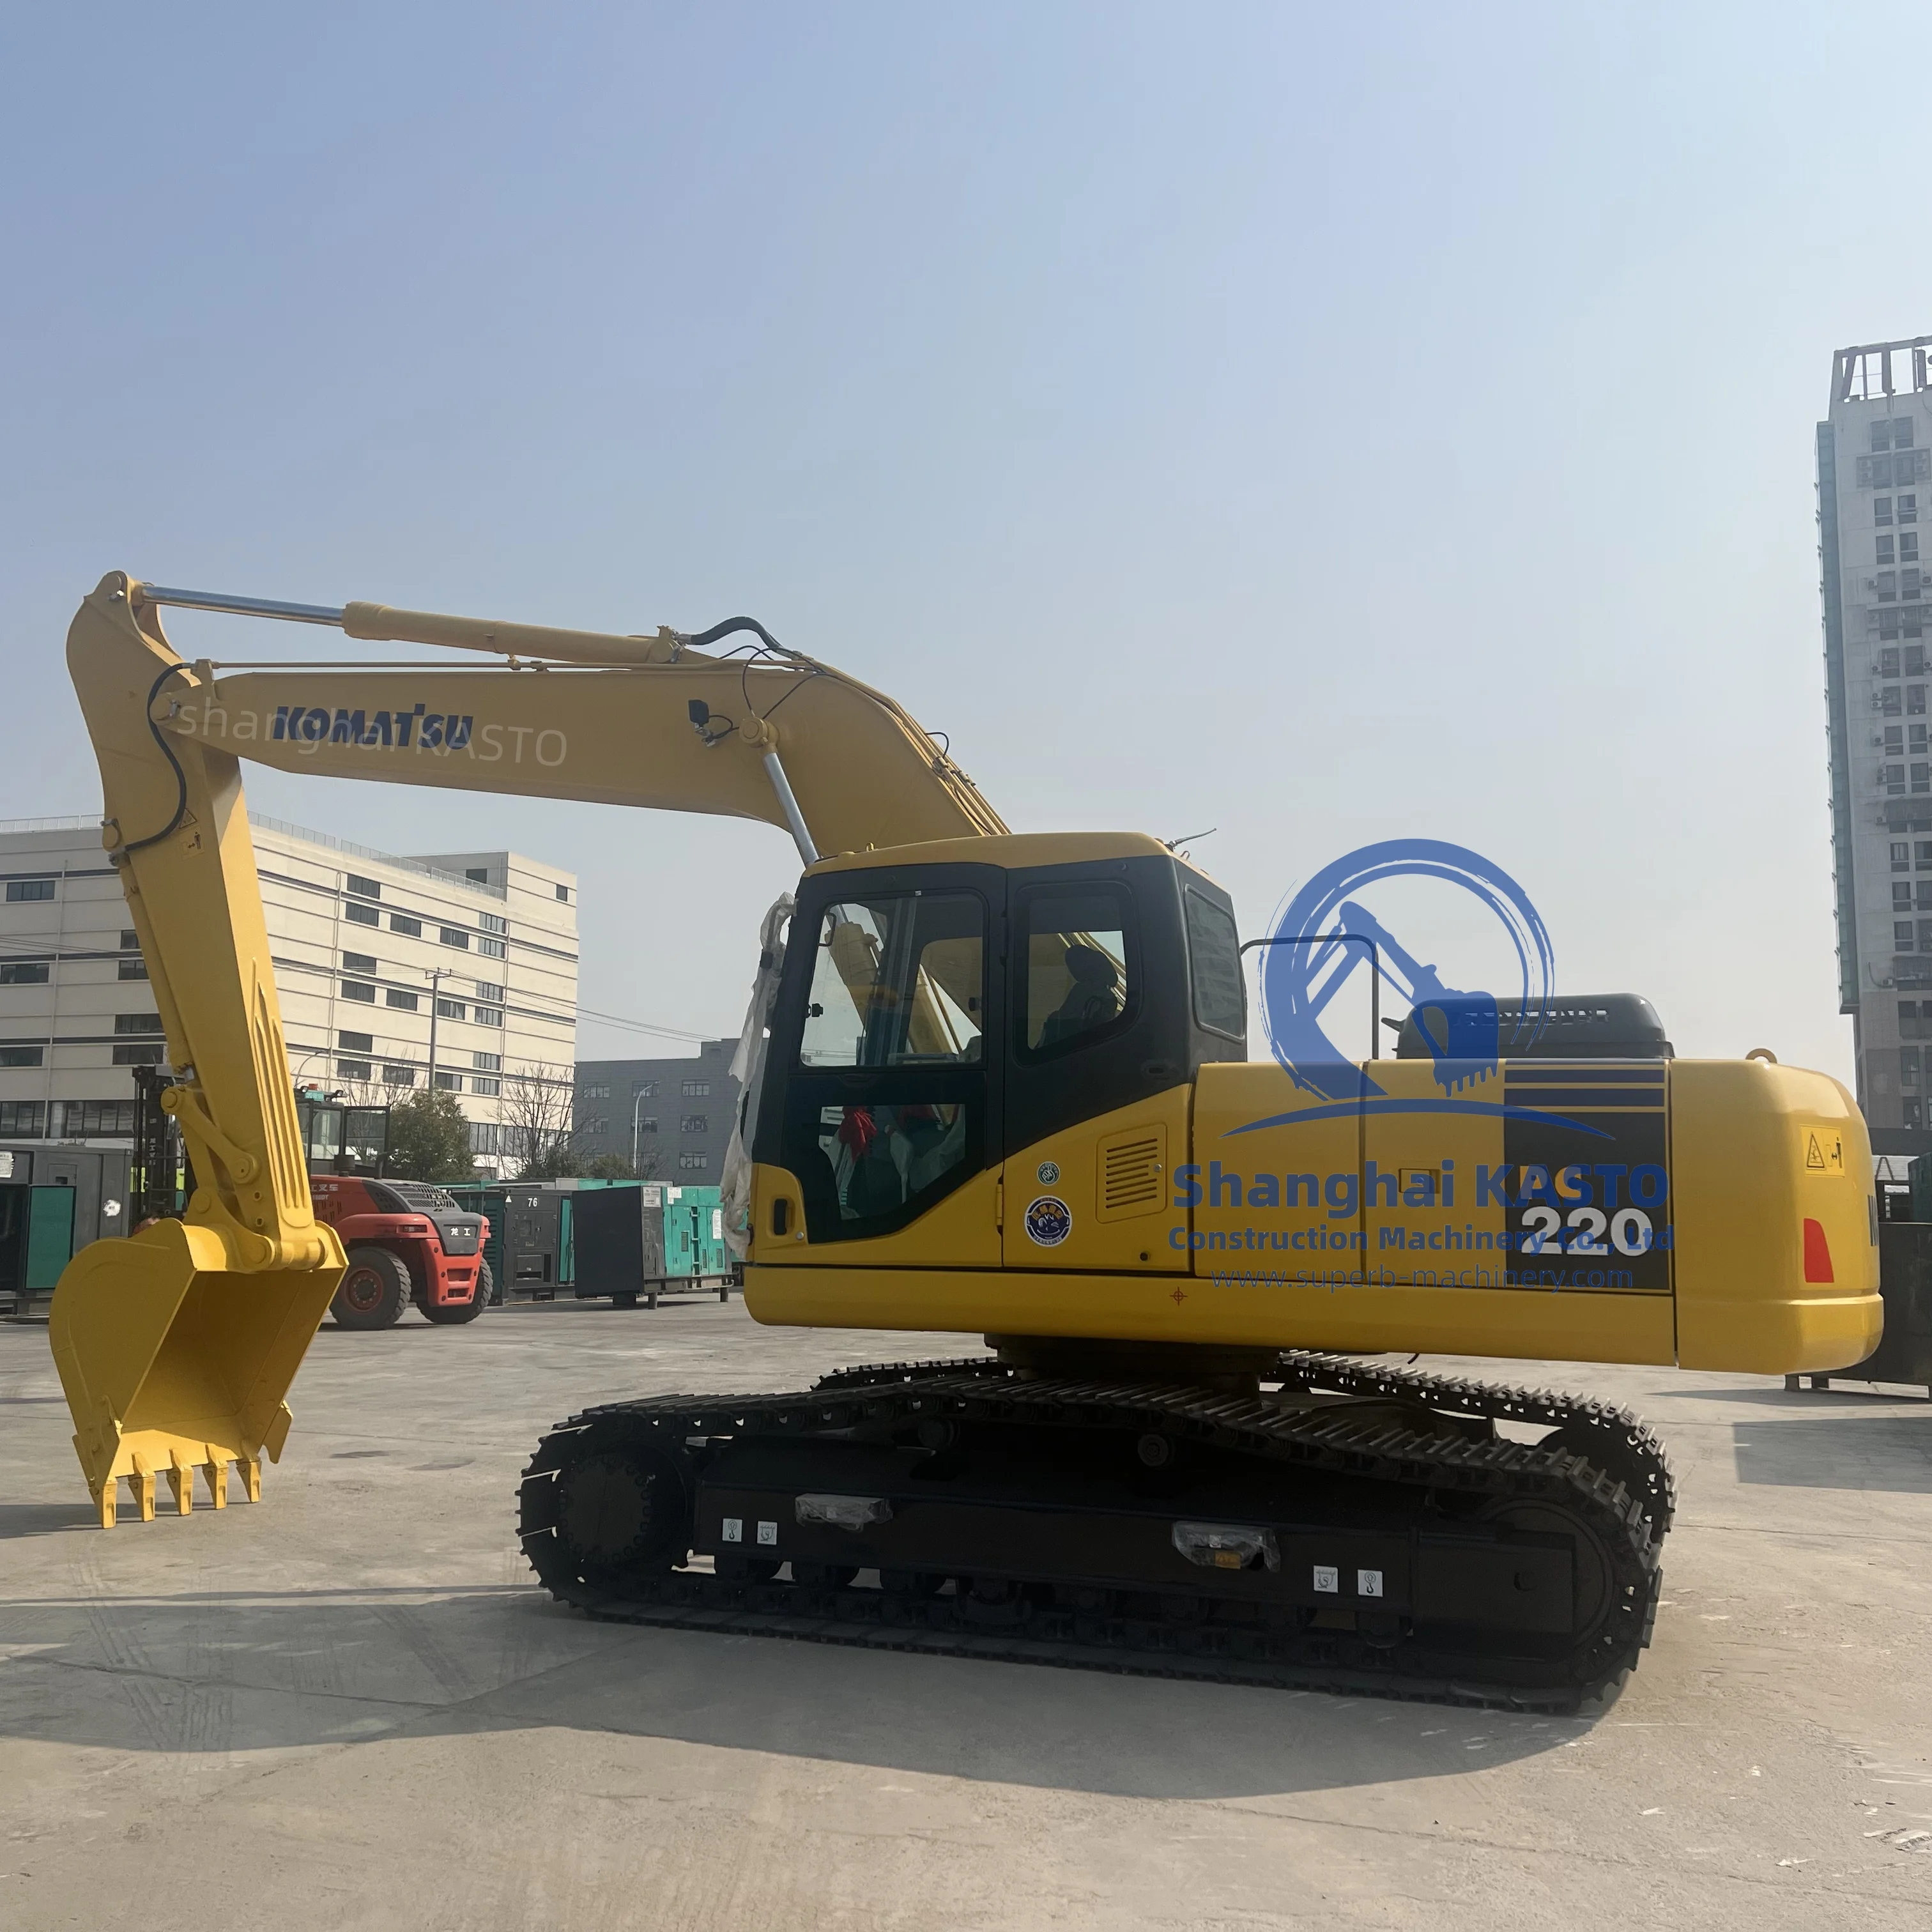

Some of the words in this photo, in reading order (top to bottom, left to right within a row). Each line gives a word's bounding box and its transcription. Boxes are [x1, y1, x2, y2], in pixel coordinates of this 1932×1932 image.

[273, 703, 473, 750] KOMATSU
[528, 1197, 538, 1208] 76
[1520, 1166, 1582, 1200] PC
[1521, 1206, 1653, 1257] 220
